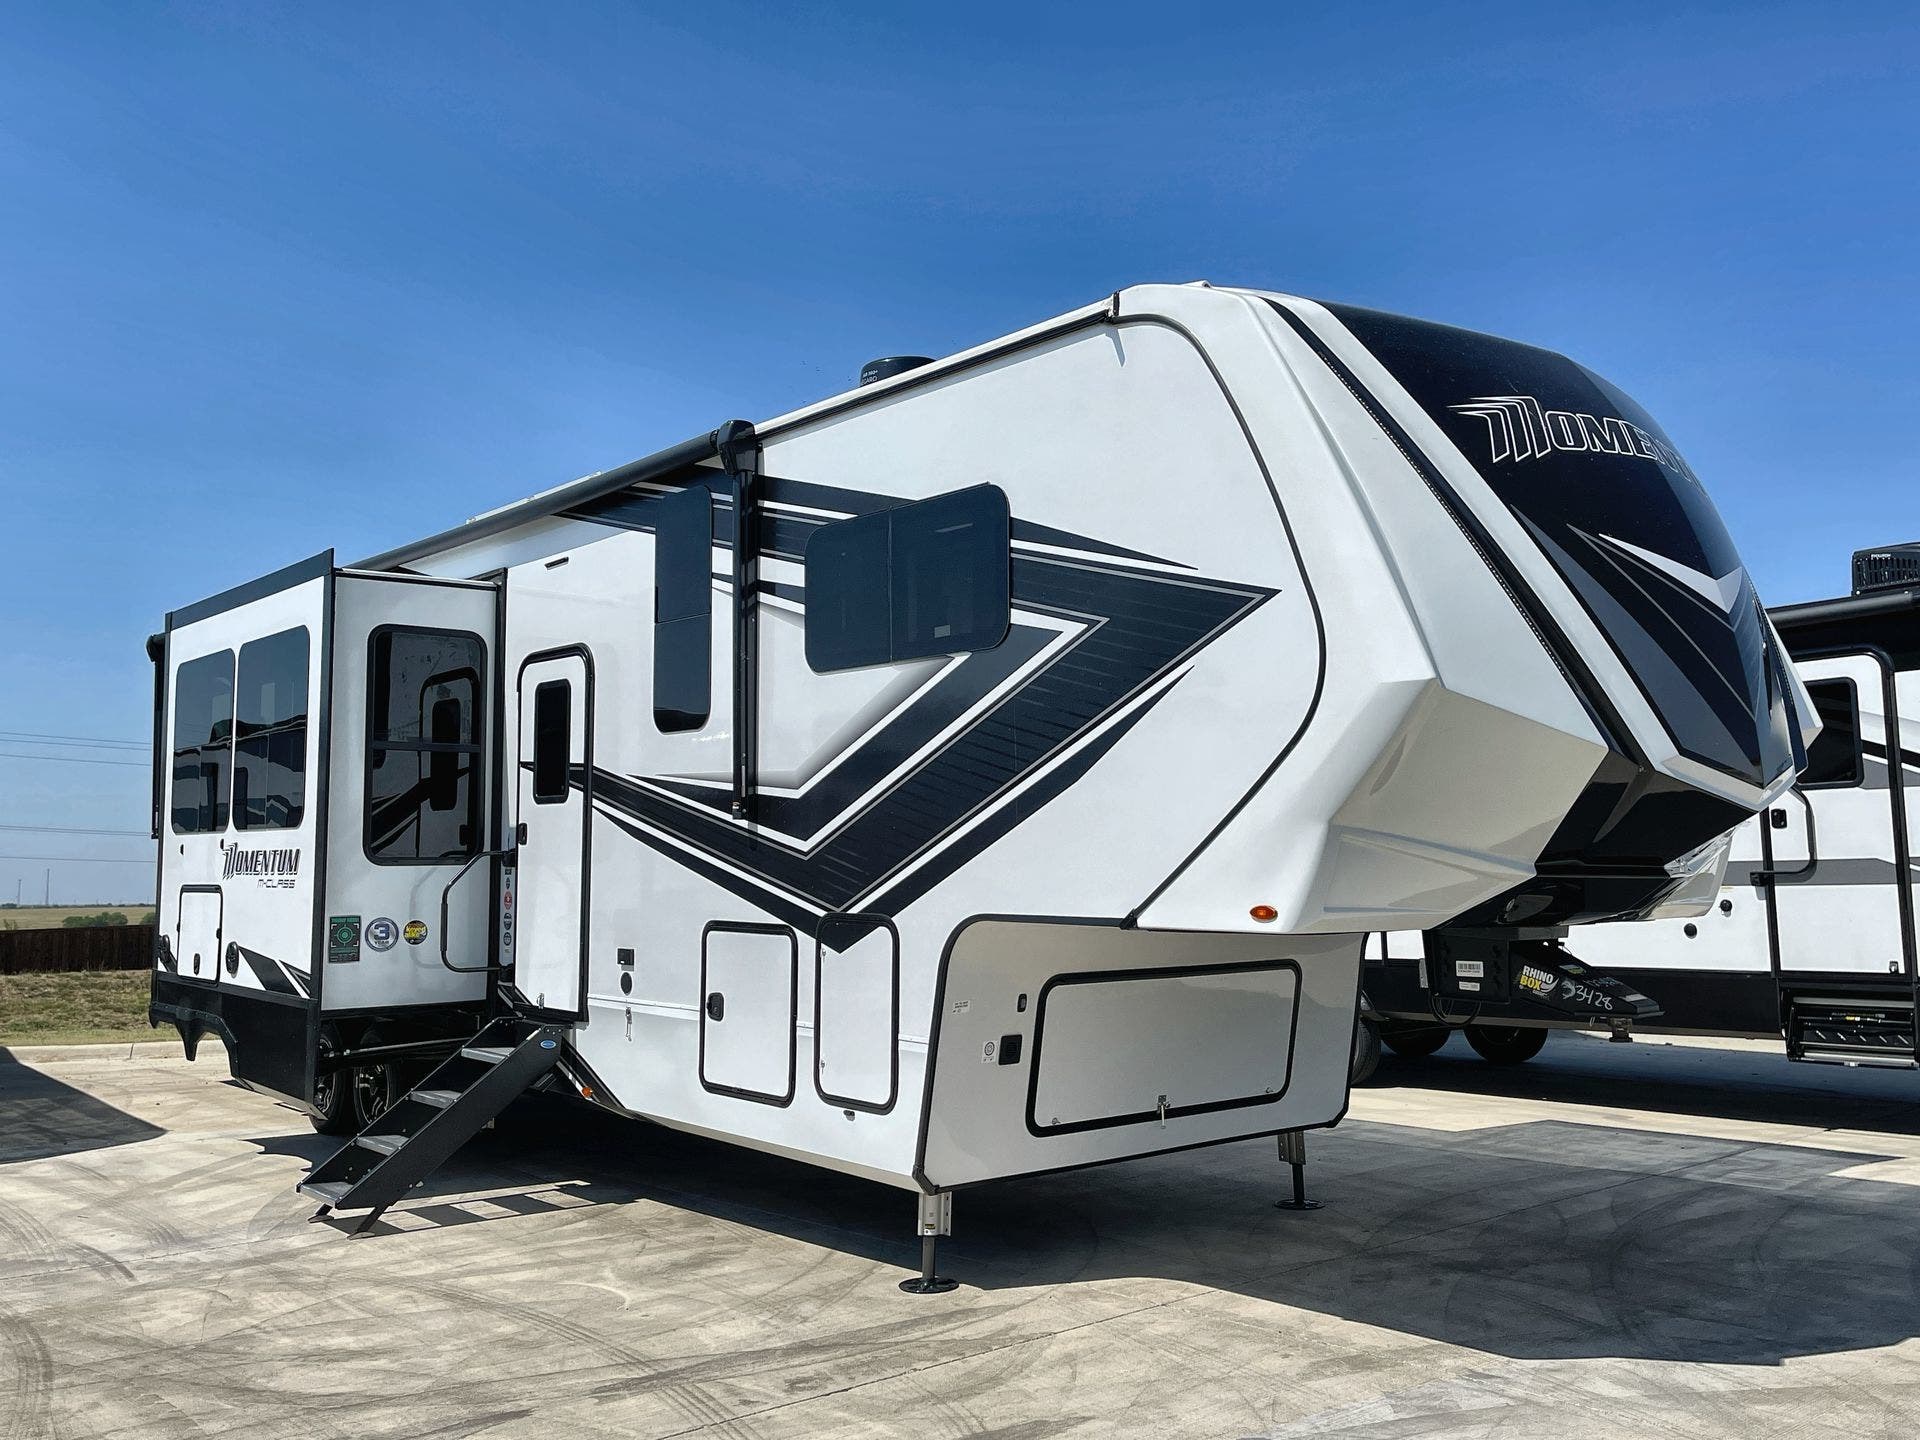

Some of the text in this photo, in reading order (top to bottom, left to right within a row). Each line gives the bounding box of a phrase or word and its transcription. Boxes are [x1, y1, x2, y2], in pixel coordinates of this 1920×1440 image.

[222, 842, 300, 880] MOMENTUM
[372, 923, 390, 941] 3
[1520, 975, 1541, 991] BOX
[1523, 965, 1554, 984] RHINO
